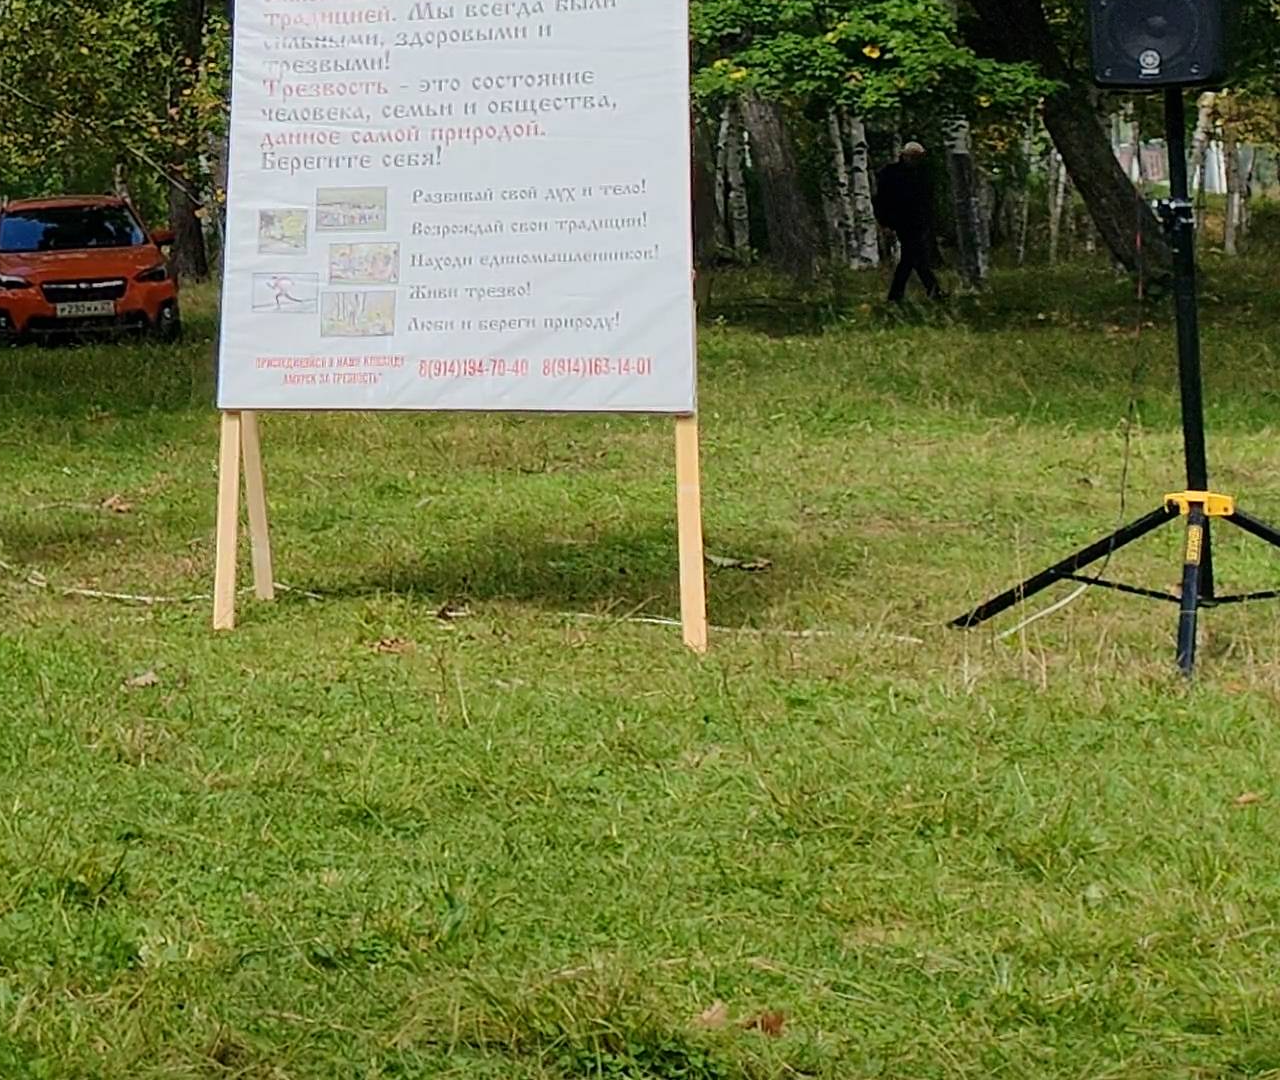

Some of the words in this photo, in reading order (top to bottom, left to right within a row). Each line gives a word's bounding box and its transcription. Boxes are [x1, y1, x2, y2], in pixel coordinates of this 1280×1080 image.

[407, 3, 454, 20] Мы
[465, 0, 545, 19] всегда
[395, 27, 528, 48] здоровыми
[538, 24, 552, 38] и
[263, 52, 391, 75] трезвыми!
[263, 78, 388, 101] Трезвость
[419, 78, 460, 93] это
[472, 71, 595, 90] состояние
[261, 104, 371, 122] человека,
[382, 102, 452, 119] семьи
[464, 102, 477, 116] и
[487, 94, 617, 115] общества,
[261, 130, 341, 149] данное
[351, 124, 420, 144] самой
[431, 121, 546, 146] природой.
[261, 151, 371, 174] Берегите
[382, 146, 442, 168] себя!
[412, 188, 493, 204] Развивай
[501, 187, 538, 201] свой
[544, 187, 576, 203] дух
[582, 187, 592, 197] и
[599, 179, 646, 196] тело!
[411, 220, 504, 238] Возрождай
[555, 211, 647, 233] традиции!
[410, 253, 473, 271] Находи
[479, 244, 659, 268] единомышленников!
[409, 284, 458, 300] Живи
[464, 282, 531, 301] трезво!
[408, 317, 454, 332] Люби
[461, 319, 471, 330] и
[477, 318, 536, 333] береги
[543, 312, 621, 332] природу!
[419, 359, 529, 379] 8(914)194-70-40
